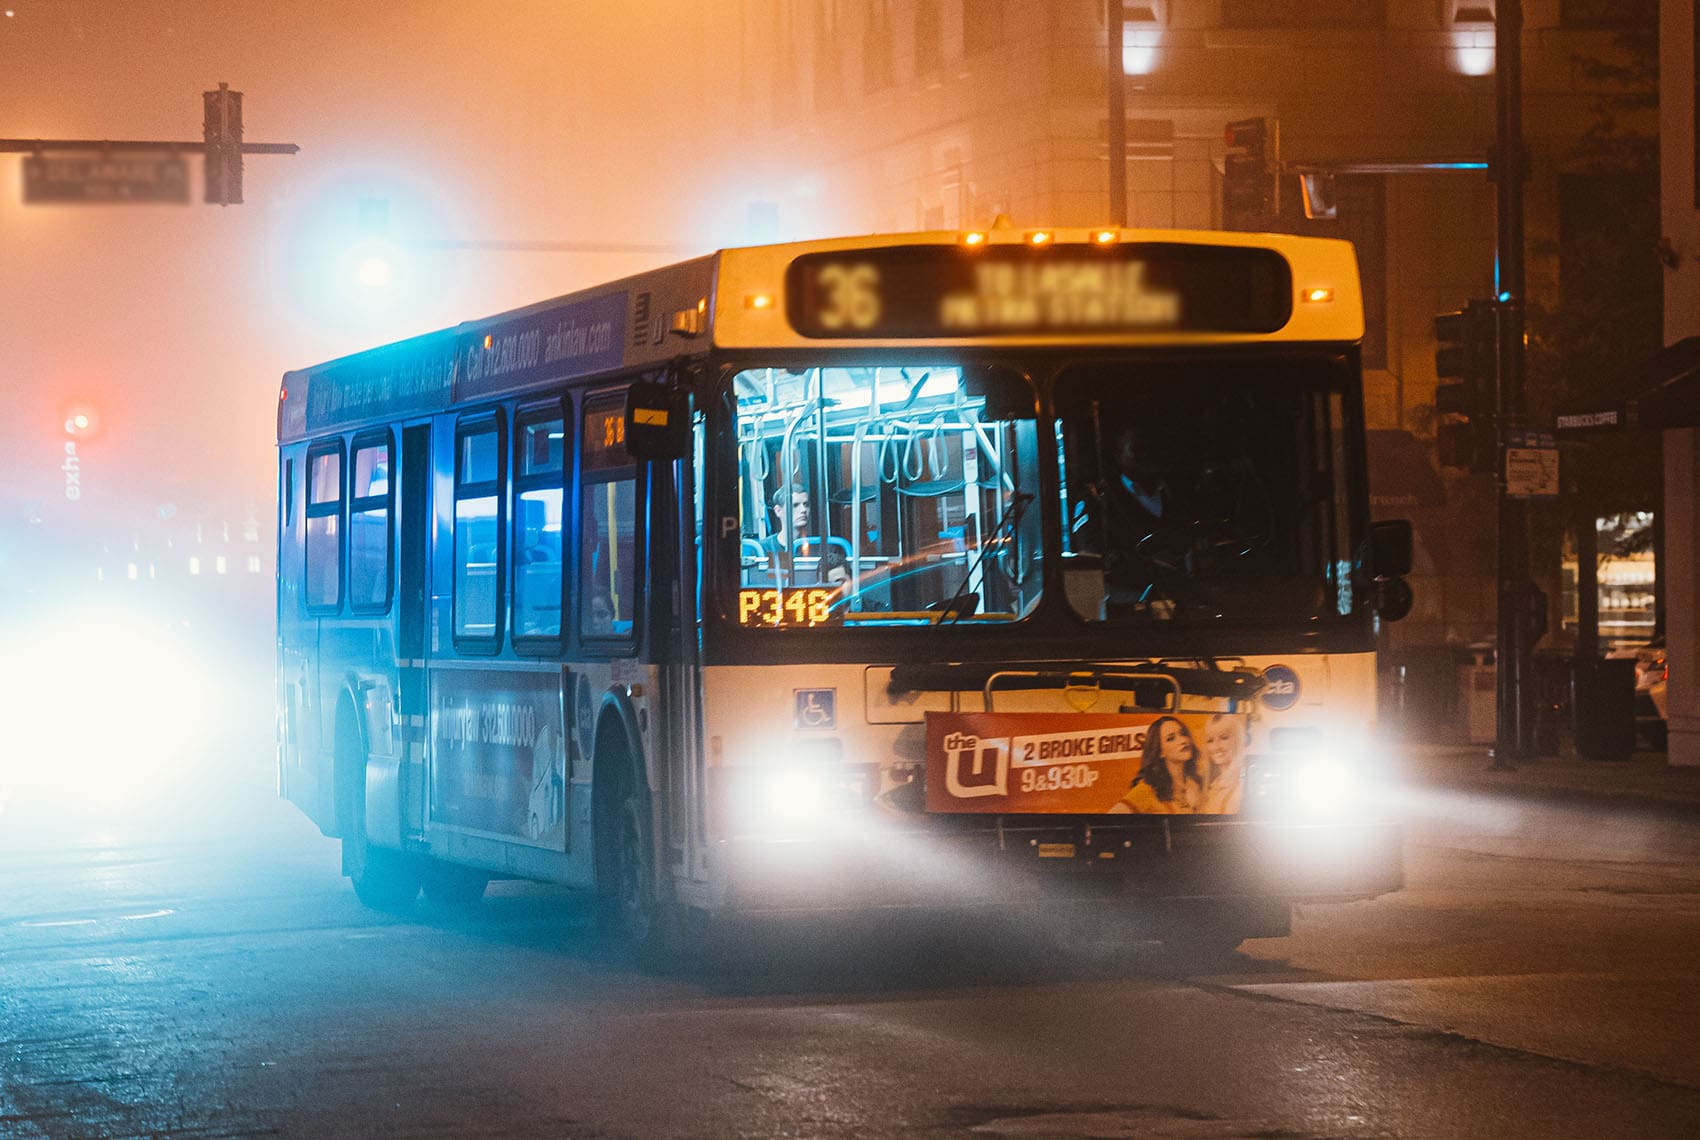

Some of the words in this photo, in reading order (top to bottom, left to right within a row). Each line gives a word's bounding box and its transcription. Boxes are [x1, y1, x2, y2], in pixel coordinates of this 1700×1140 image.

[946, 734, 976, 750] the
[1024, 742, 1036, 761] 2
[1039, 738, 1095, 760] BROKE
[1099, 732, 1147, 755] GIRLS
